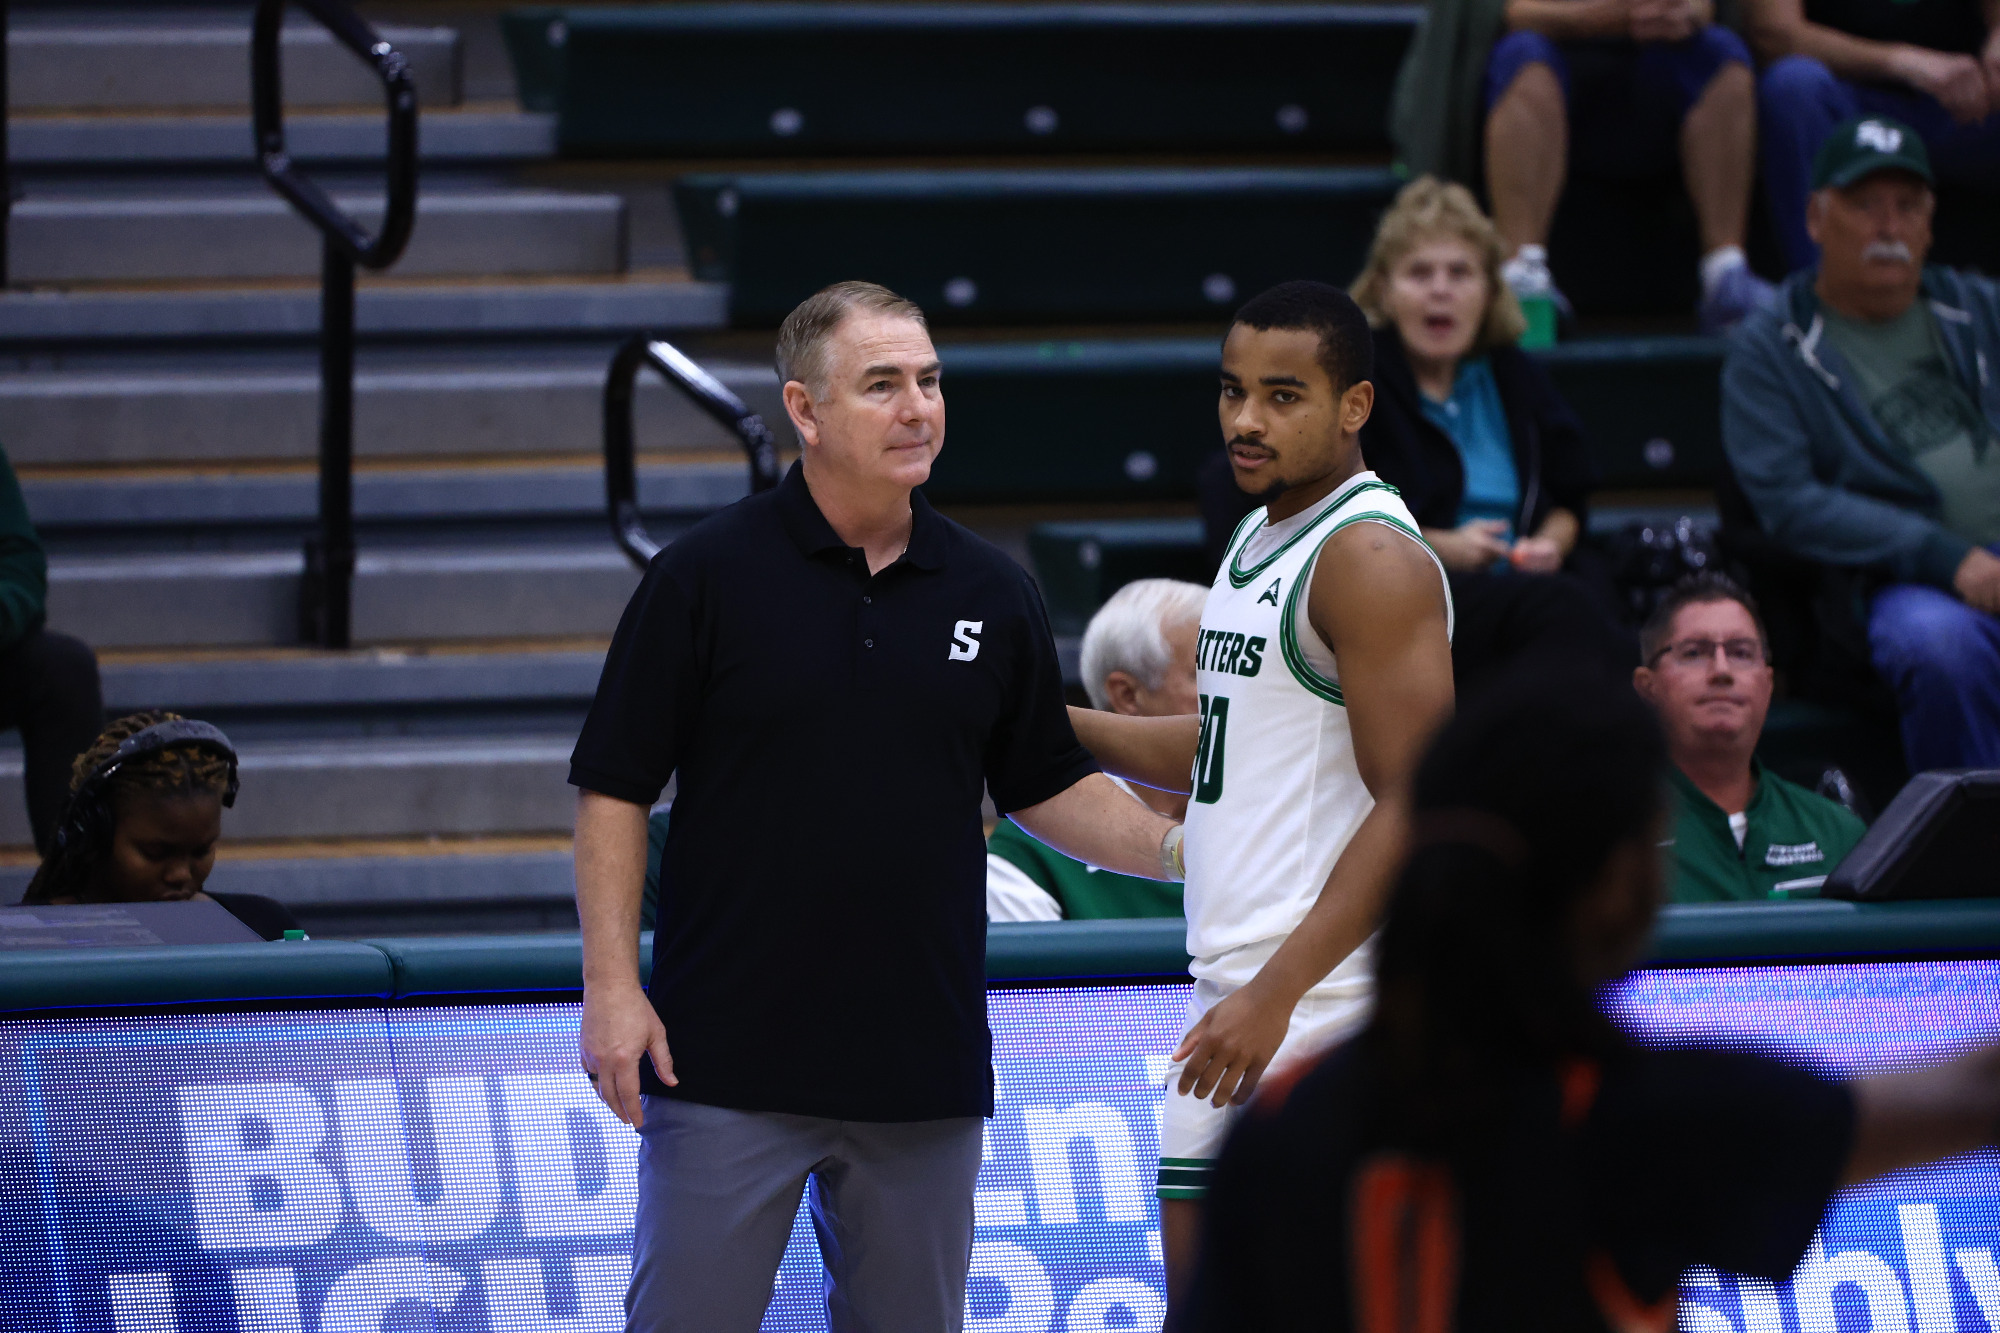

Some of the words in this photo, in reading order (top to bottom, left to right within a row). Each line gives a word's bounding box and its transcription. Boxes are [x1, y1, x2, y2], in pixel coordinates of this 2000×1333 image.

[948, 619, 983, 662] S
[1196, 625, 1267, 677] ATTERS
[177, 1072, 640, 1250] BUD
